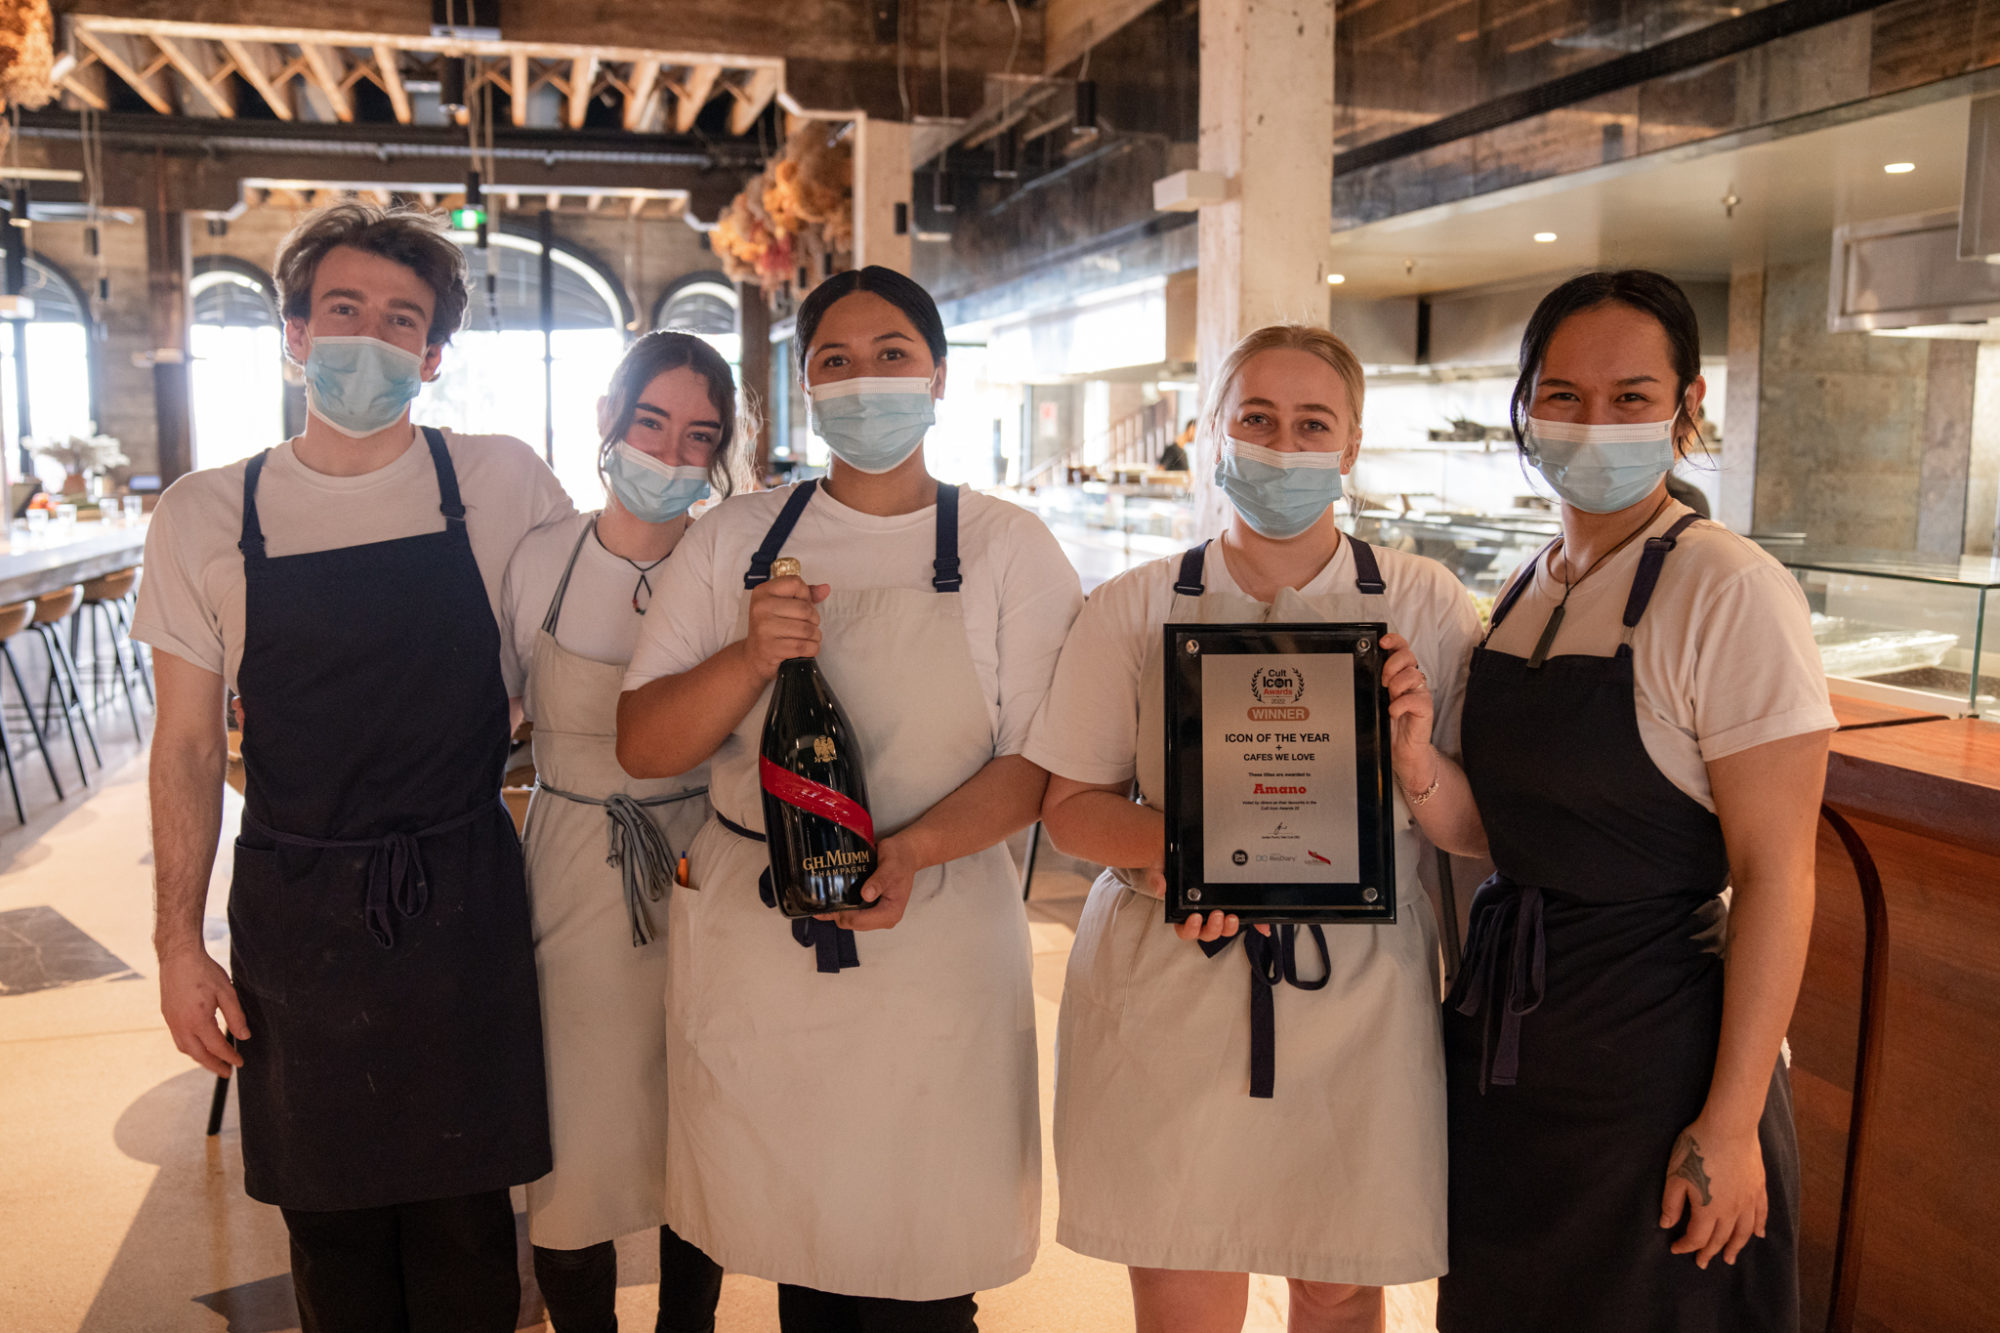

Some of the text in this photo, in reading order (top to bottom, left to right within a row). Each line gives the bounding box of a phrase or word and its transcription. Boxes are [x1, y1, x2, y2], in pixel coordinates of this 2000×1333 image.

[1268, 669, 1287, 677] Cult
[1263, 676, 1293, 688] Icon
[1263, 688, 1293, 696] Awards
[1252, 708, 1305, 720] WINNER
[1225, 733, 1330, 743] ICON OF THE YEAR
[1243, 753, 1316, 761] CAFES WE LOVE
[1253, 783, 1307, 794] Amano
